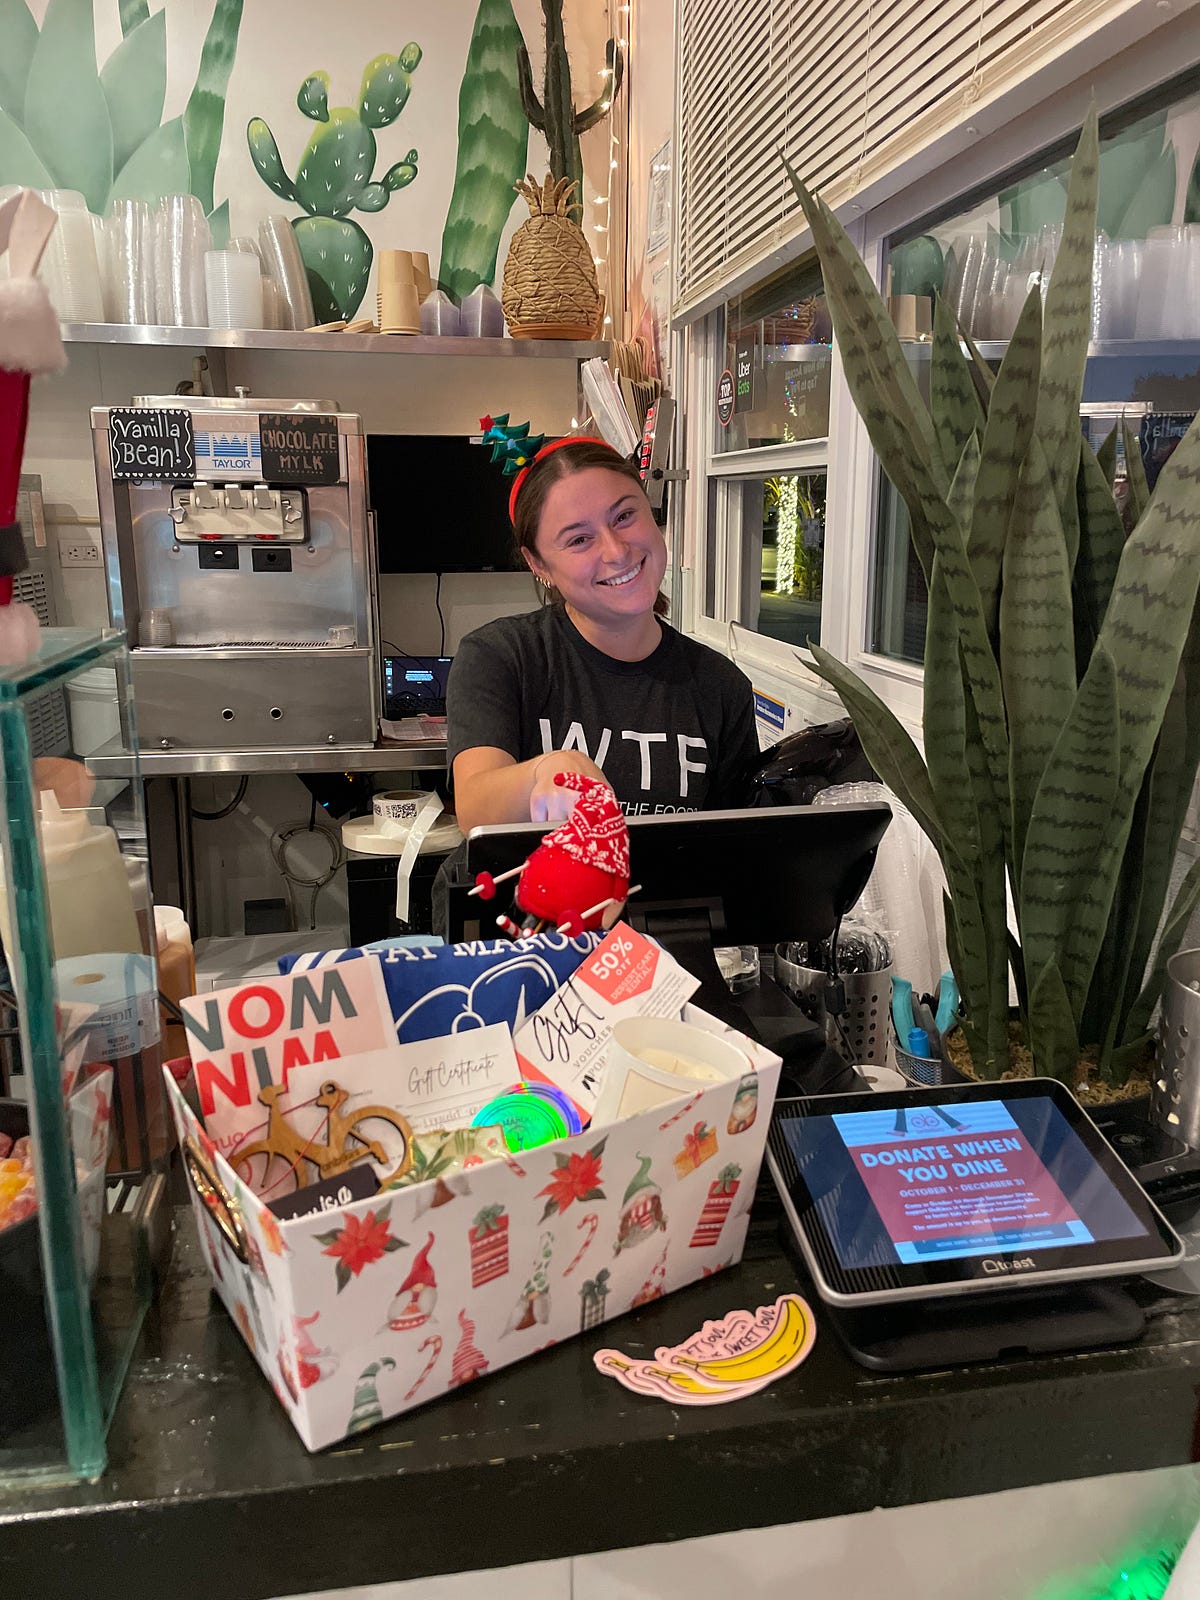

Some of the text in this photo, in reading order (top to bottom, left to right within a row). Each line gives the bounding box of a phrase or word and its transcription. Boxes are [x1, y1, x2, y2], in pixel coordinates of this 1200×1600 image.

[738, 361, 751, 378] Uber
[720, 383, 731, 398] TOP
[738, 380, 750, 396] Eats
[115, 414, 181, 439] Vanilla
[261, 430, 337, 450] CHOCOLATE
[120, 438, 182, 468] Bean!
[212, 459, 251, 468] TAYLOR
[279, 455, 324, 470] MYLK
[590, 936, 633, 980] 50%
[615, 957, 631, 976] OFF
[610, 949, 656, 1000] DESSERT CART
[626, 966, 652, 994] RENTAL
[181, 969, 358, 1051] NOM
[573, 1024, 613, 1068] VOUCHER
[408, 1054, 498, 1095] Gift Certificate
[860, 1137, 1022, 1168] DONATE WHEN
[898, 1158, 1008, 1183] YOU DINE
[899, 1186, 947, 1198] OCTOBER
[960, 1179, 1014, 1192] DECEMBER
[1014, 1178, 1025, 1187] 31
[997, 1257, 1036, 1270] toast
[723, 1308, 776, 1355] SWEET SOUL
